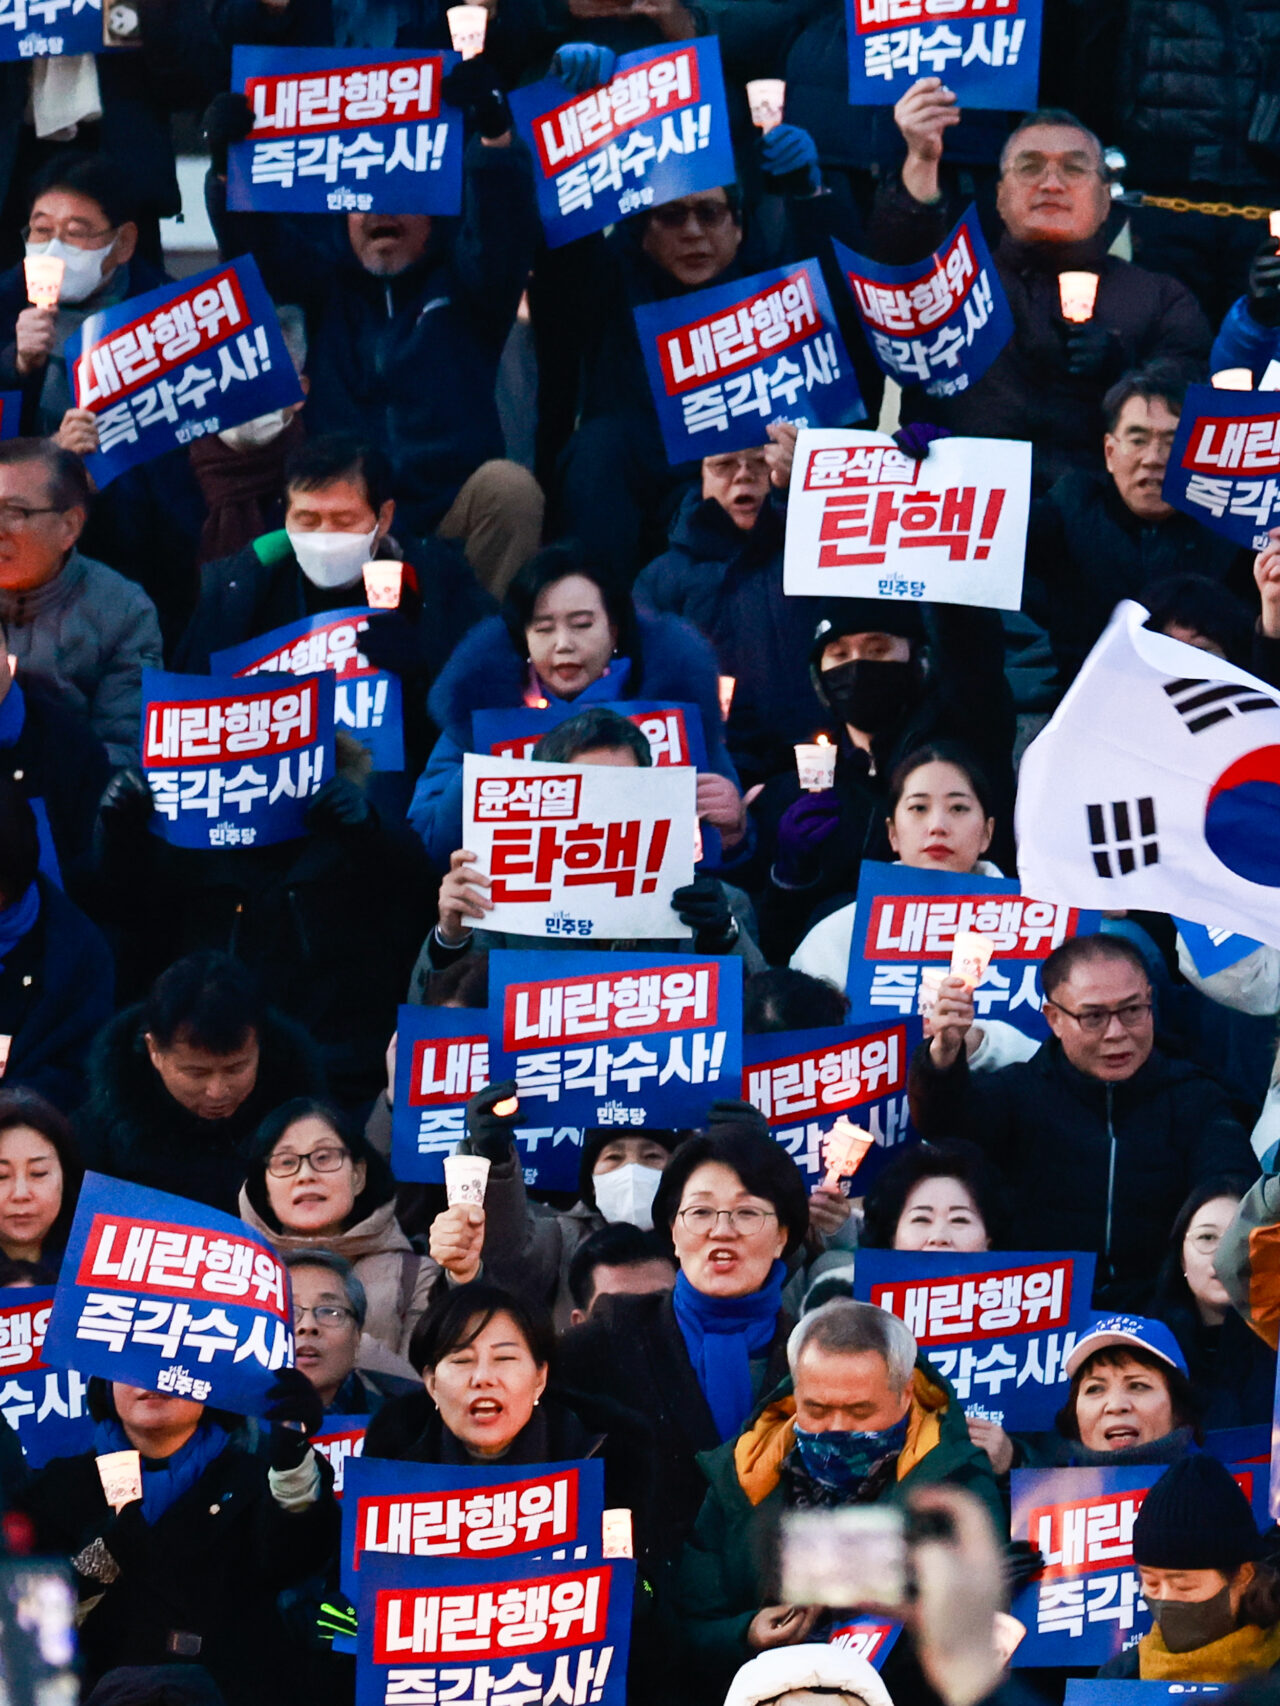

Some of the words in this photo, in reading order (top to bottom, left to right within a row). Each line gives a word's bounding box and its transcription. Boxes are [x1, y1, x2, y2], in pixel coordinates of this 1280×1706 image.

[19, 34, 63, 56] 민주당
[865, 20, 1024, 80] 즉각수사!
[254, 65, 432, 128] 내란행위
[541, 54, 692, 165] 내란행위
[252, 124, 447, 187] 즉각수사!
[555, 105, 710, 214] 즉각수사!
[327, 188, 372, 210] 민주당
[855, 236, 972, 329] 내란행위
[80, 280, 246, 402] 내란행위
[668, 277, 814, 384] 내란행위
[875, 270, 993, 379] 즉각수사!
[95, 325, 271, 452] 즉각수사!
[682, 335, 839, 433] 즉각수사!
[806, 447, 918, 487] 윤석열
[817, 487, 1005, 568] 탄핵!
[877, 579, 926, 595] 민주당
[148, 689, 310, 757] 내란행위
[148, 746, 323, 820] 즉각수사!
[477, 775, 577, 818] 윤석열
[210, 823, 256, 845] 민주당
[490, 820, 670, 905] 탄핵!
[545, 917, 594, 936] 민주당
[876, 895, 1070, 955] 내란행위
[515, 971, 708, 1040] 내란행위
[515, 1032, 726, 1101] 즉각수사!
[598, 1107, 646, 1125] 민주당
[90, 1225, 283, 1320] 내란행위
[881, 1269, 1064, 1340] 내란행위
[77, 1293, 293, 1370] 즉각수사!
[158, 1370, 211, 1400] 민주당
[365, 1480, 567, 1555] 내란행위
[387, 1576, 600, 1652] 내란행위
[385, 1647, 613, 1706] 즉각수사!
